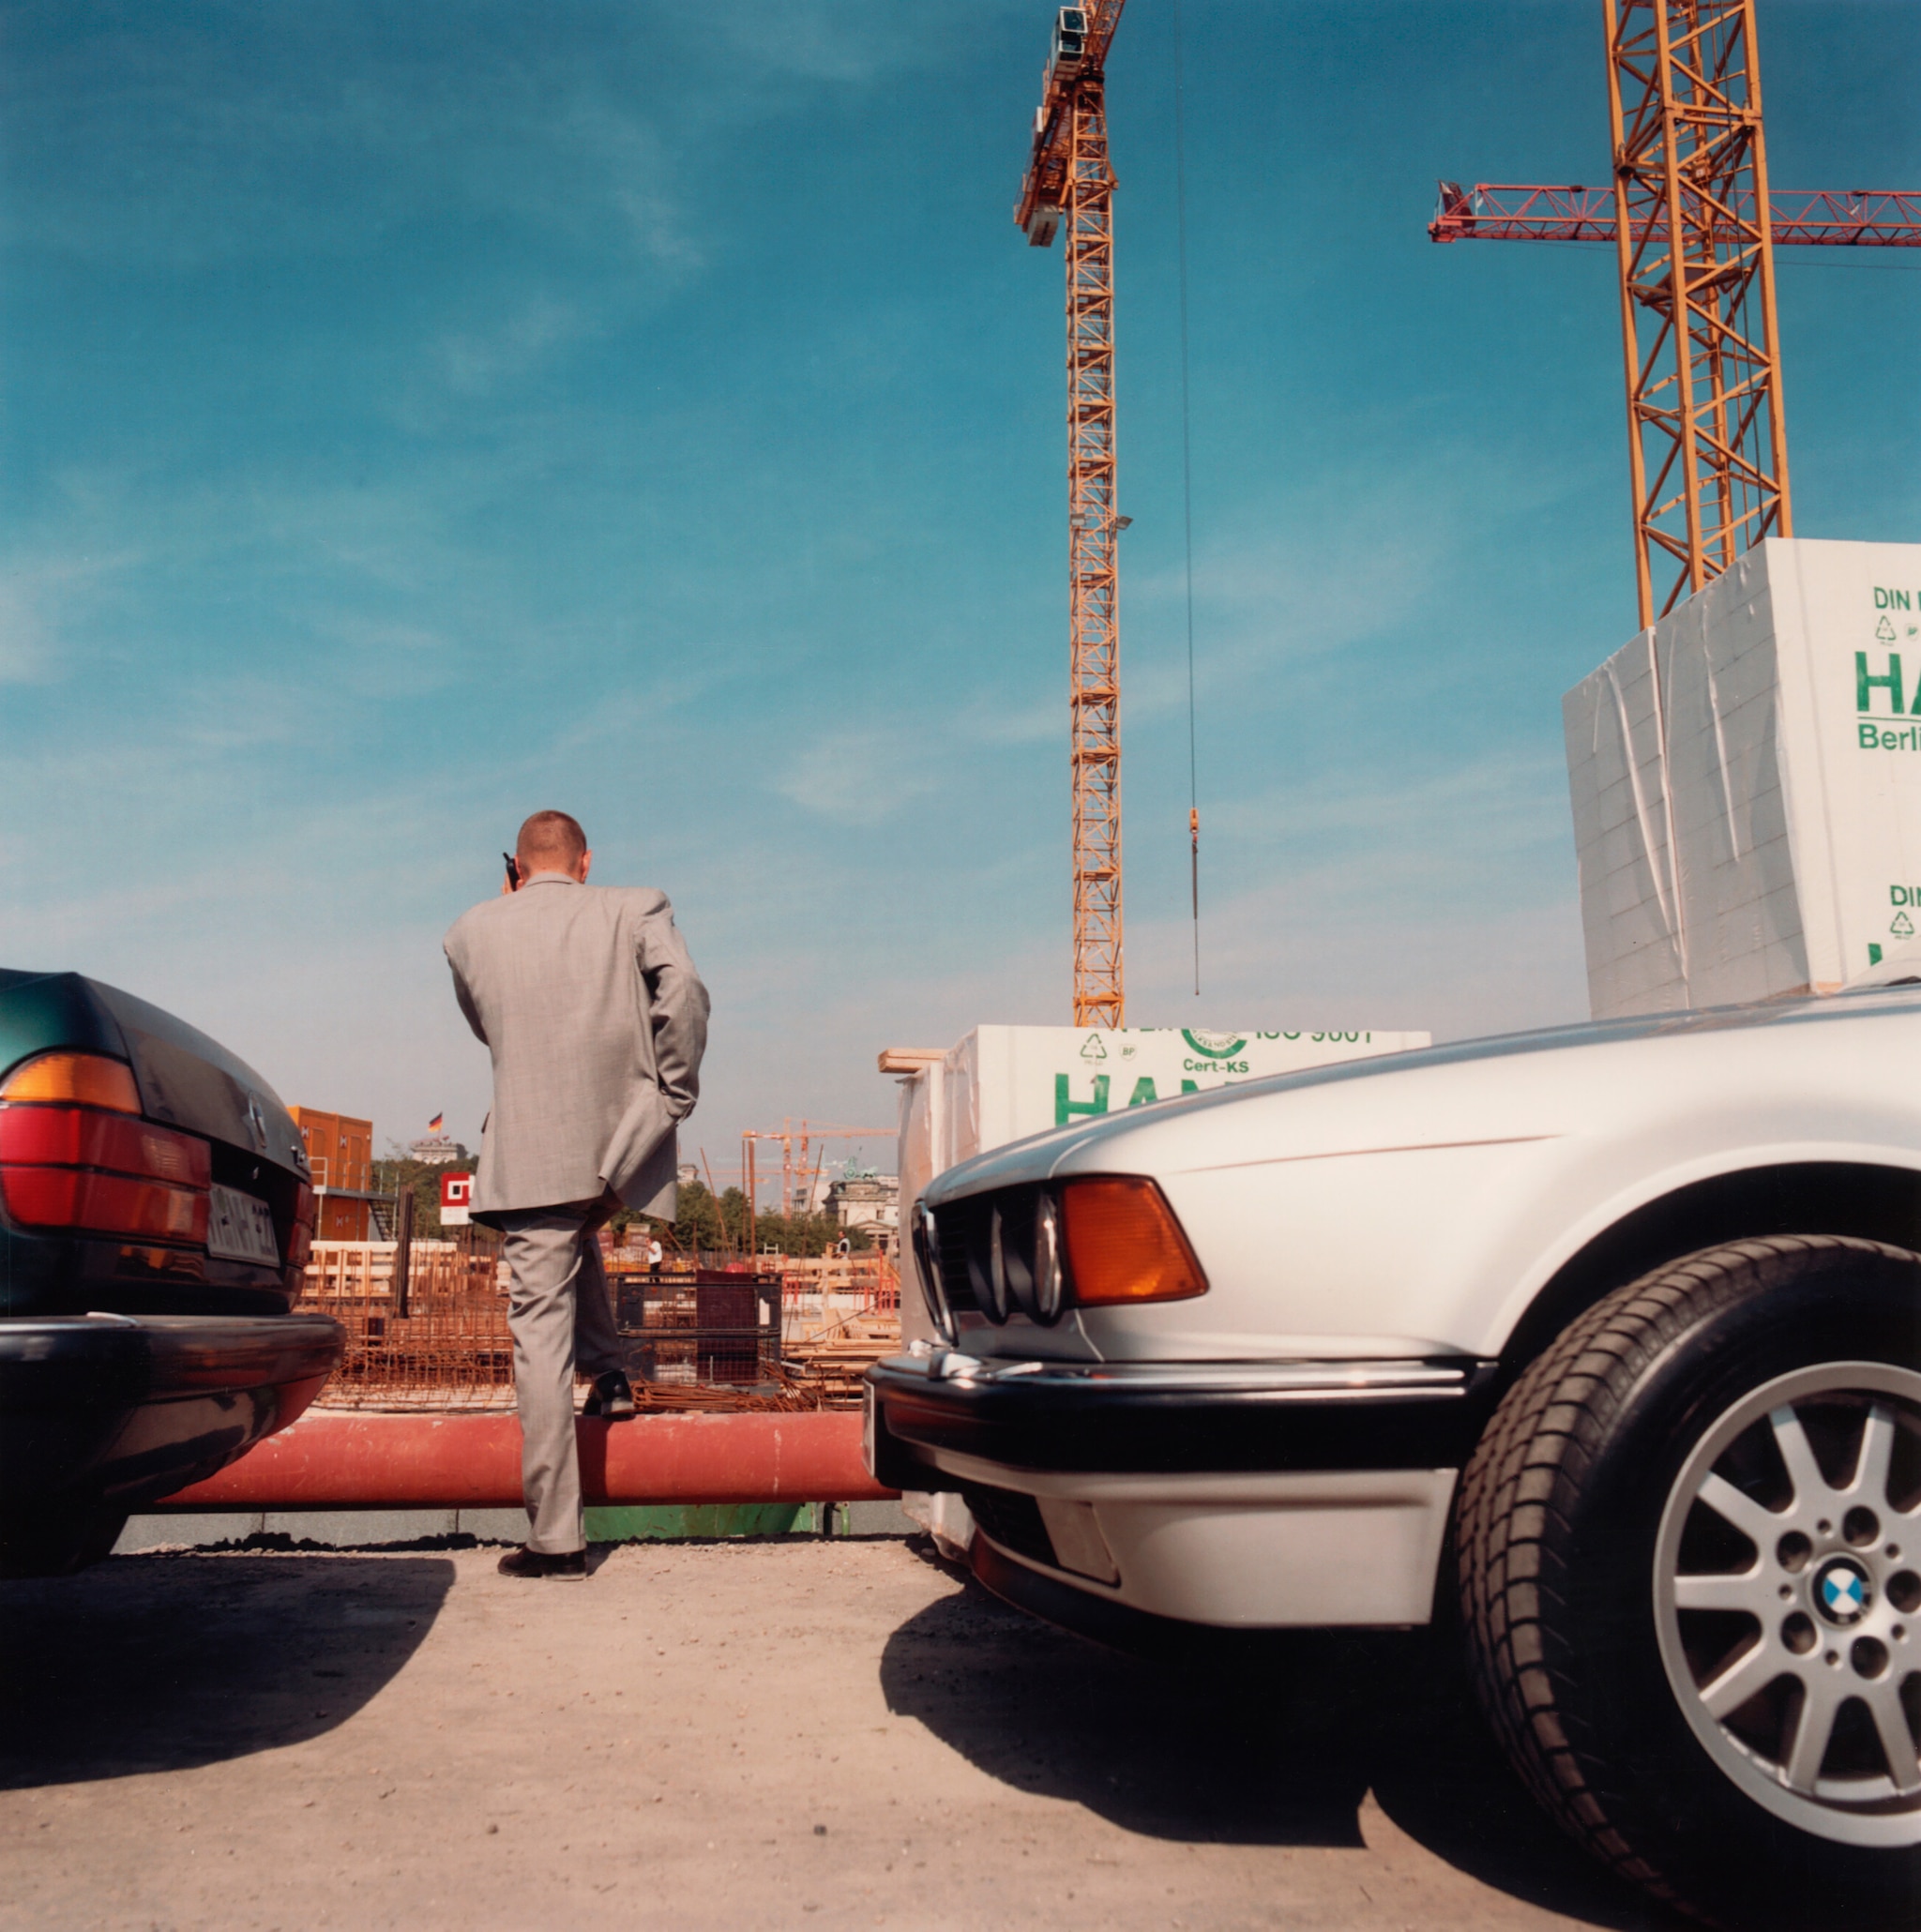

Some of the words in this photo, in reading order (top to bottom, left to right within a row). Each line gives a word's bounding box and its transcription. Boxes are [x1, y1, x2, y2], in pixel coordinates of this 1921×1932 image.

[1874, 586, 1911, 611] DIN
[1122, 1047, 1135, 1056] BP
[1183, 1058, 1249, 1073] Cert-KS
